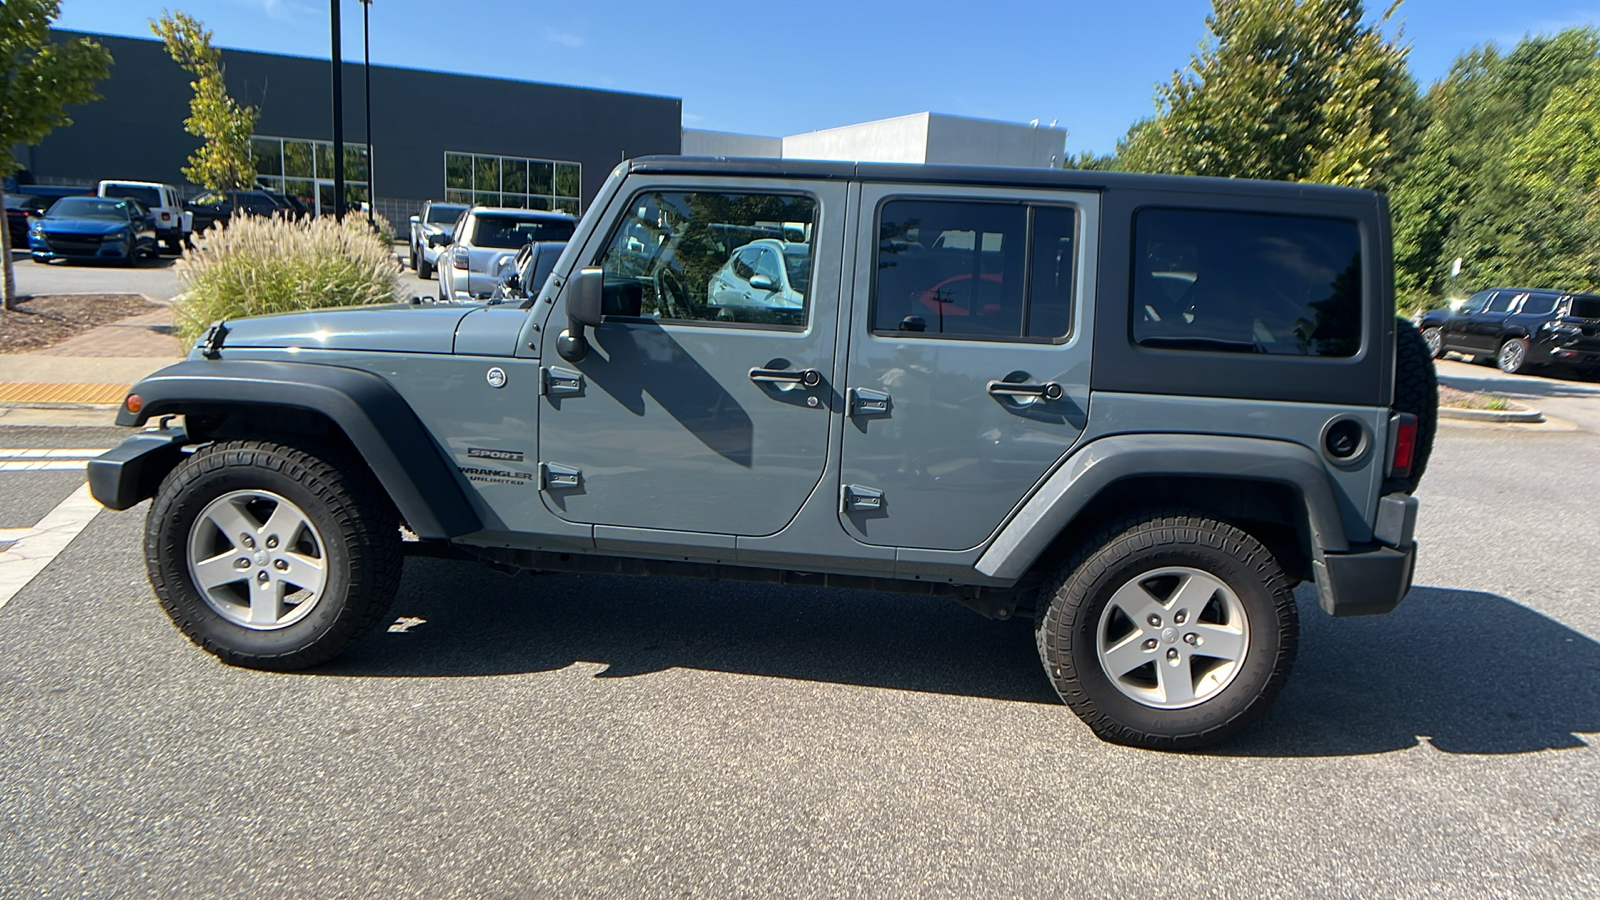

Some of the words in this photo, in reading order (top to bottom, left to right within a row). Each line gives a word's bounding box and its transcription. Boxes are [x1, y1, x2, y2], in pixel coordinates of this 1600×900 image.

[470, 449, 520, 460] SPORT
[458, 467, 533, 480] WRANGLER
[470, 476, 524, 485] UNLIMITED
